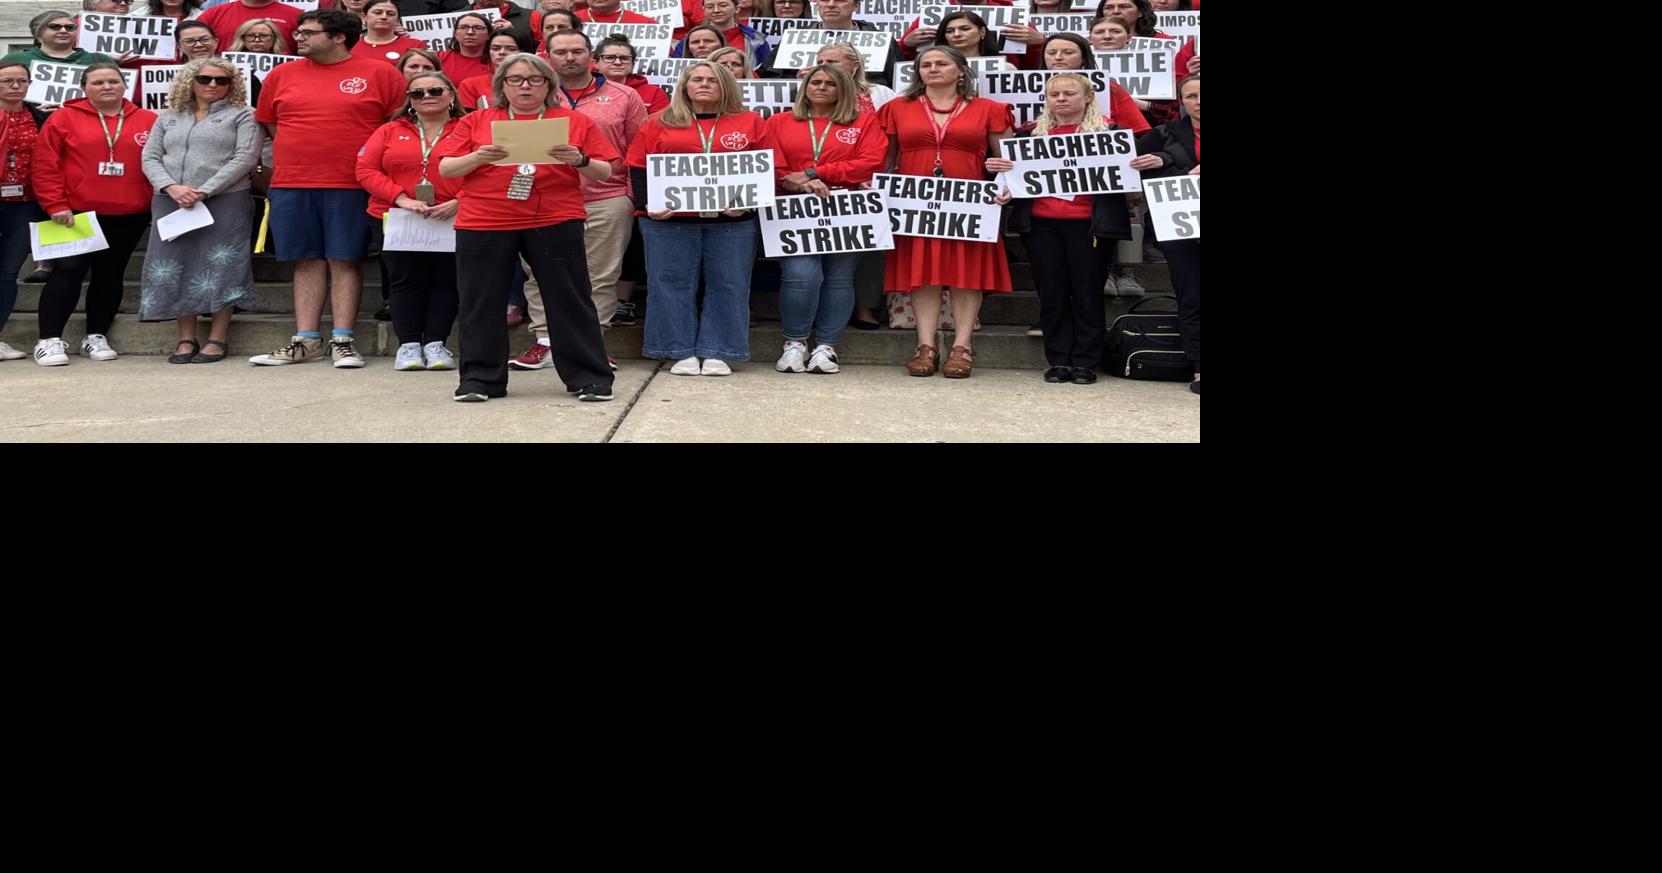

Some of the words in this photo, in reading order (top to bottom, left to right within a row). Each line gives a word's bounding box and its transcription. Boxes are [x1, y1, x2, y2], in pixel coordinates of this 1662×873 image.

[84, 14, 173, 37] SETTLE
[406, 18, 443, 32] DON'T
[924, 6, 1025, 27] STLE
[1031, 16, 1095, 31] PPORT
[96, 36, 158, 56] NOW
[786, 31, 887, 47] TEACHERS
[789, 51, 871, 69] STE
[1094, 53, 1166, 73] TTLE
[145, 70, 179, 83] DON'
[986, 72, 1105, 93] TEACS
[45, 85, 84, 103] NO
[1004, 131, 1131, 162] TEACHERS
[650, 152, 769, 177] TEACHERS
[1063, 158, 1077, 167] ON
[704, 177, 718, 185] ON
[876, 175, 999, 205] TEACHERS
[1023, 166, 1124, 196] STRIKE
[664, 183, 758, 211] STRIKE
[927, 202, 941, 210] ON
[818, 218, 832, 227] ON
[888, 208, 982, 239] STRIKE
[779, 225, 876, 255] STRIKE
